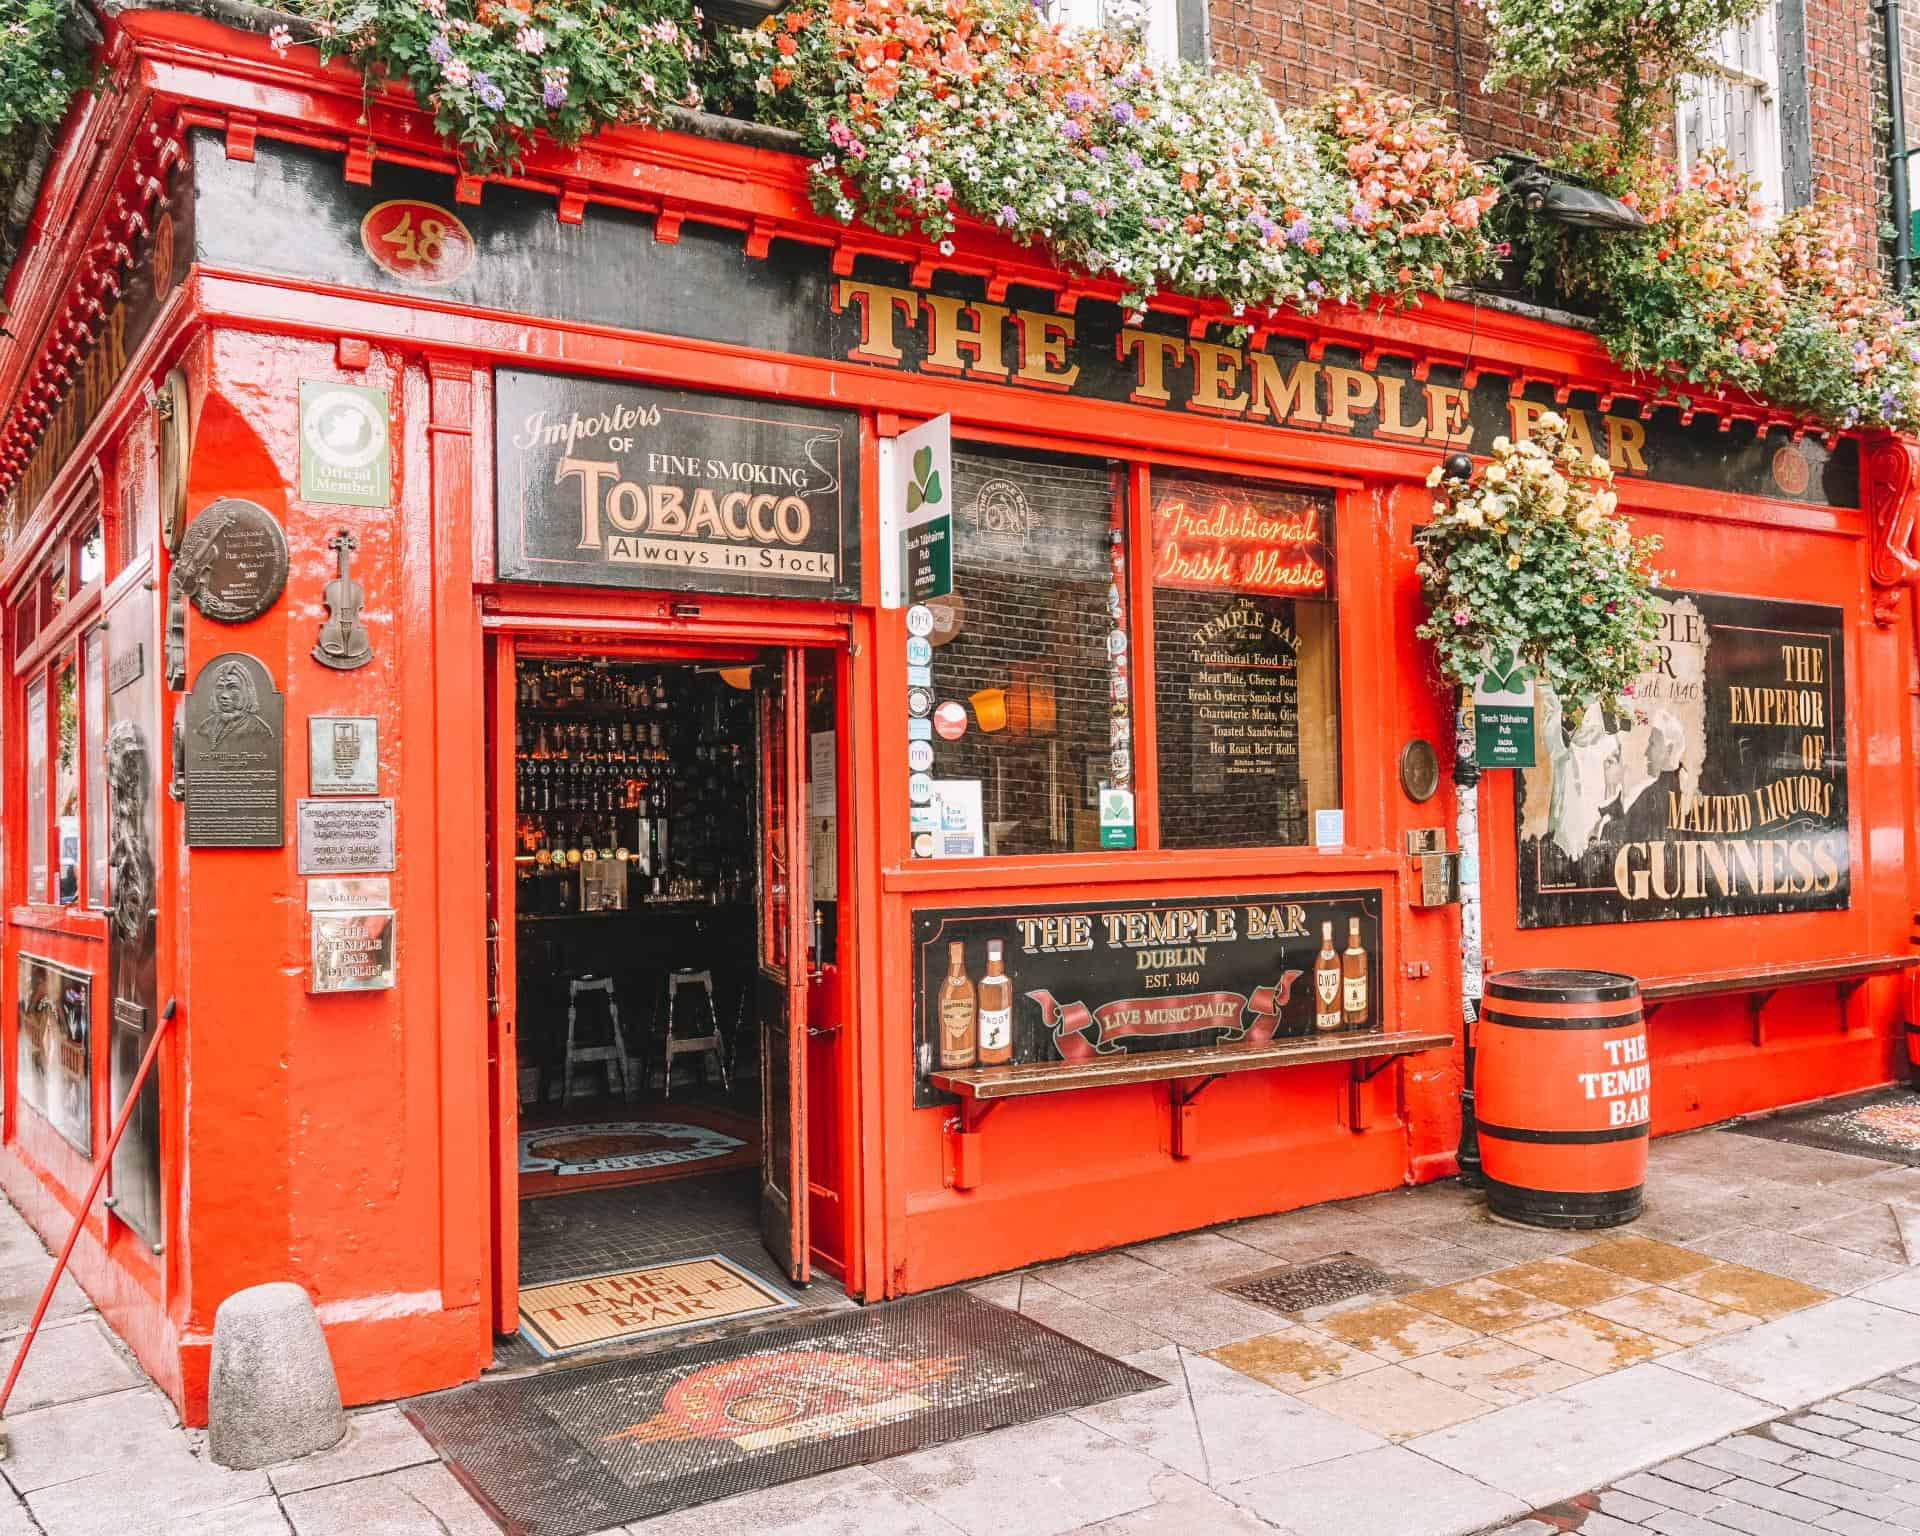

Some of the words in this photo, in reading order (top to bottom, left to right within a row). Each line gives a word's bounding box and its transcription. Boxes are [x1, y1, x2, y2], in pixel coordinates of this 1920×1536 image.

[382, 210, 445, 264] 48
[831, 280, 1080, 392] THE
[1116, 328, 1475, 449] TEMPLE
[1506, 398, 1649, 476] BAR
[513, 402, 661, 456] Importers
[609, 437, 633, 453] OF
[319, 466, 371, 481] Official
[648, 454, 701, 476] FINE
[706, 460, 809, 488] SMOKING
[313, 479, 377, 496] Member
[555, 455, 811, 549] TOBACCO
[1161, 503, 1319, 541] Traditional
[613, 538, 709, 565] Always
[725, 549, 747, 568] in
[759, 550, 830, 574] Stock
[1158, 542, 1231, 581] Irish
[1245, 550, 1325, 587] Music
[1239, 598, 1256, 608] The
[1193, 611, 1264, 646] TEMPLE
[1270, 618, 1302, 653] BAR
[1192, 650, 1250, 664] Traditional
[1254, 653, 1278, 666] Food
[1781, 645, 1824, 684] THE
[1249, 673, 1278, 686] Cheese
[1188, 688, 1211, 701] Fresh
[1250, 691, 1281, 703] Smoked
[1729, 686, 1825, 728] EMPEROR
[1200, 707, 1249, 719] Charcuterie
[1252, 708, 1278, 722] Meats,
[1214, 724, 1243, 737] Toasted
[1247, 725, 1293, 738] Sandwiches
[1210, 742, 1226, 754] Hot
[1229, 743, 1251, 755] Roast
[1255, 743, 1273, 755] Beef
[1276, 743, 1297, 755] Rolls
[1802, 734, 1825, 771] OF
[1667, 790, 1752, 833] MALTED
[1754, 775, 1834, 827] LIQUORS
[1614, 839, 1839, 900] GUINNESS
[1016, 915, 1094, 954] THE
[1102, 908, 1237, 949] TEMPLE
[1246, 904, 1311, 940] BAR
[327, 940, 383, 952] TEMPLE
[1136, 946, 1208, 970] DUBLIN
[1145, 973, 1172, 988] EST.
[1175, 971, 1200, 986] 1840
[1103, 1009, 1140, 1031] LIVE
[1144, 1005, 1191, 1025] MUSIC
[1194, 1001, 1238, 1020] DAILY
[1604, 1034, 1647, 1066] THE
[1609, 1095, 1649, 1126] BAR
[533, 1276, 742, 1322] TEMPLE
[570, 1271, 674, 1297] THE
[608, 1299, 715, 1327] BAR
